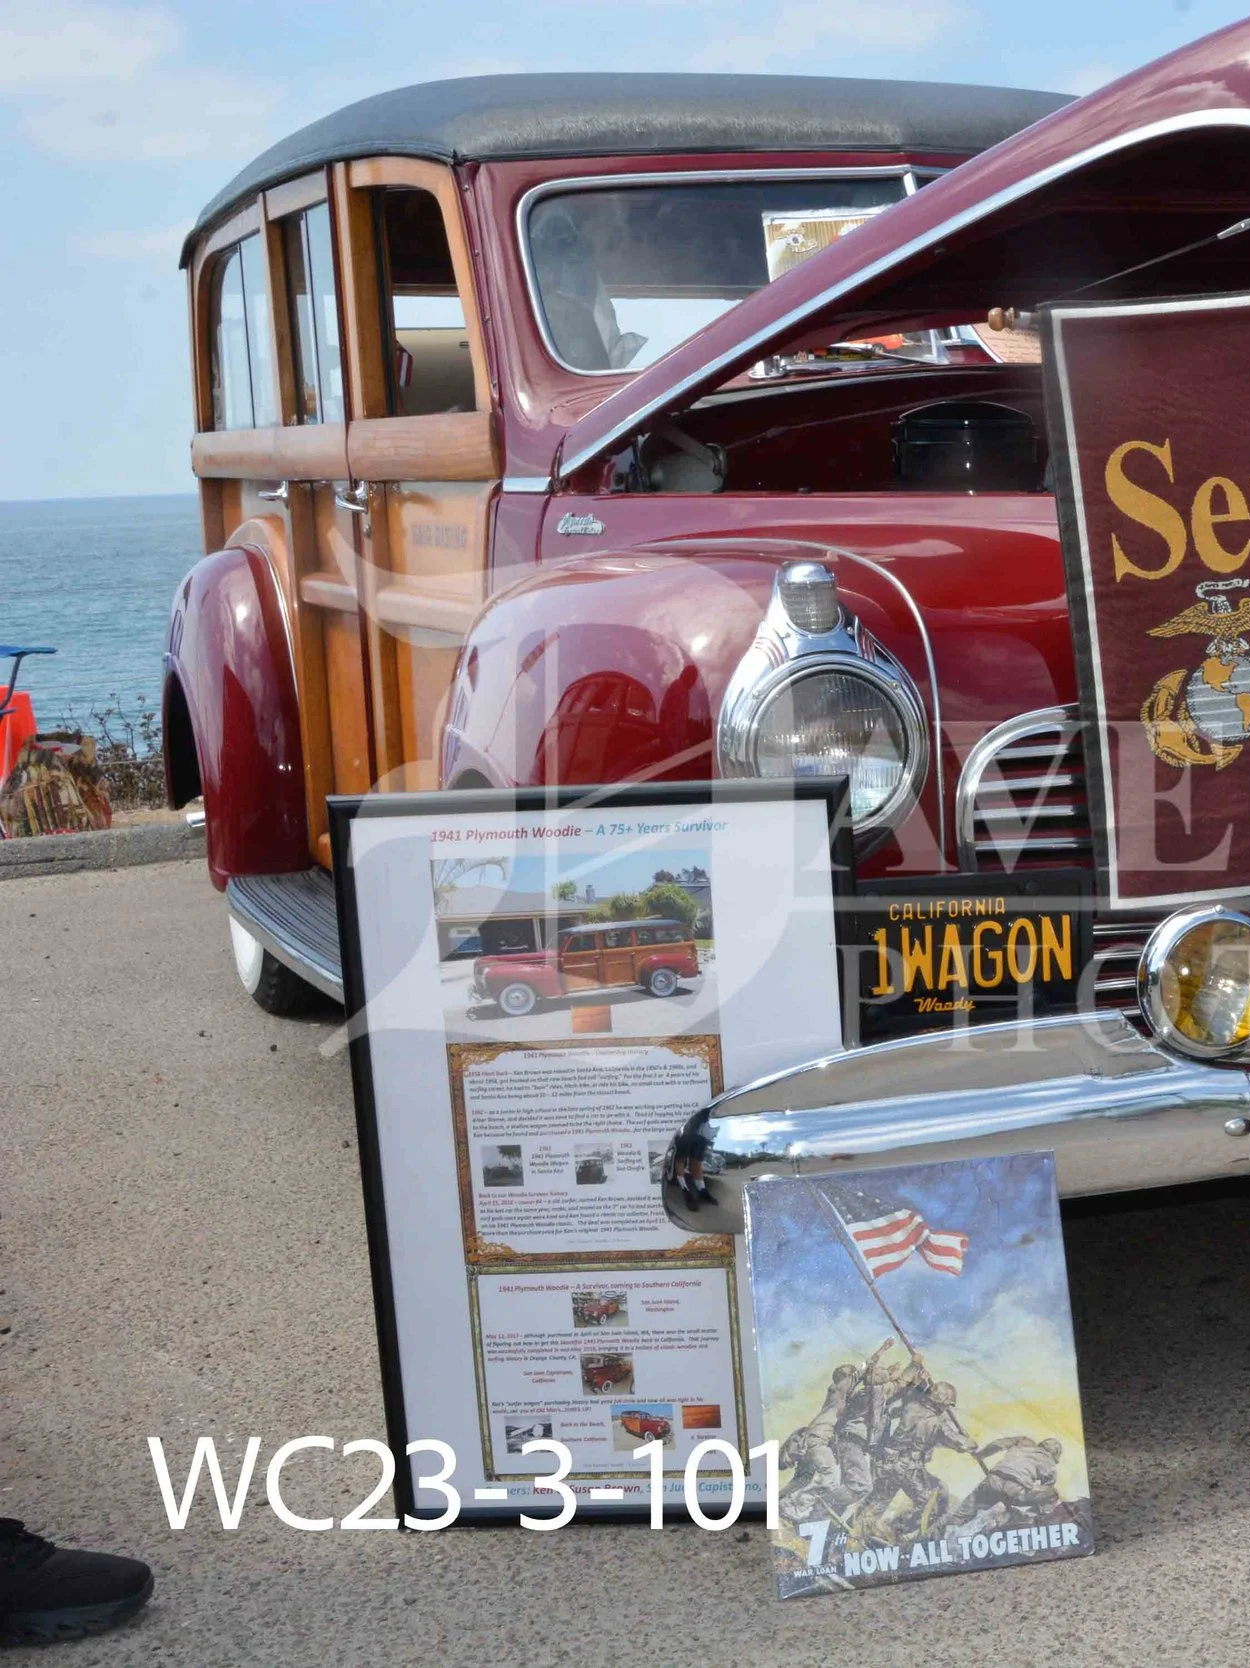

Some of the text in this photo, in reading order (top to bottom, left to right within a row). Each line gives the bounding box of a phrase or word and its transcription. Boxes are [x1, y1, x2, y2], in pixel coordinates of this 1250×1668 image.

[431, 819, 728, 844] 1941 Plymouth Woodie A 75+ Years Survivor
[889, 896, 1006, 921] CALIFORNIA
[868, 914, 1073, 996] 1WAGON
[913, 996, 976, 1013] Woody
[699, 1480, 762, 1494] Capistno,
[957, 1522, 1080, 1560] TOGETHER
[793, 1565, 837, 1578] WAR LOAN
